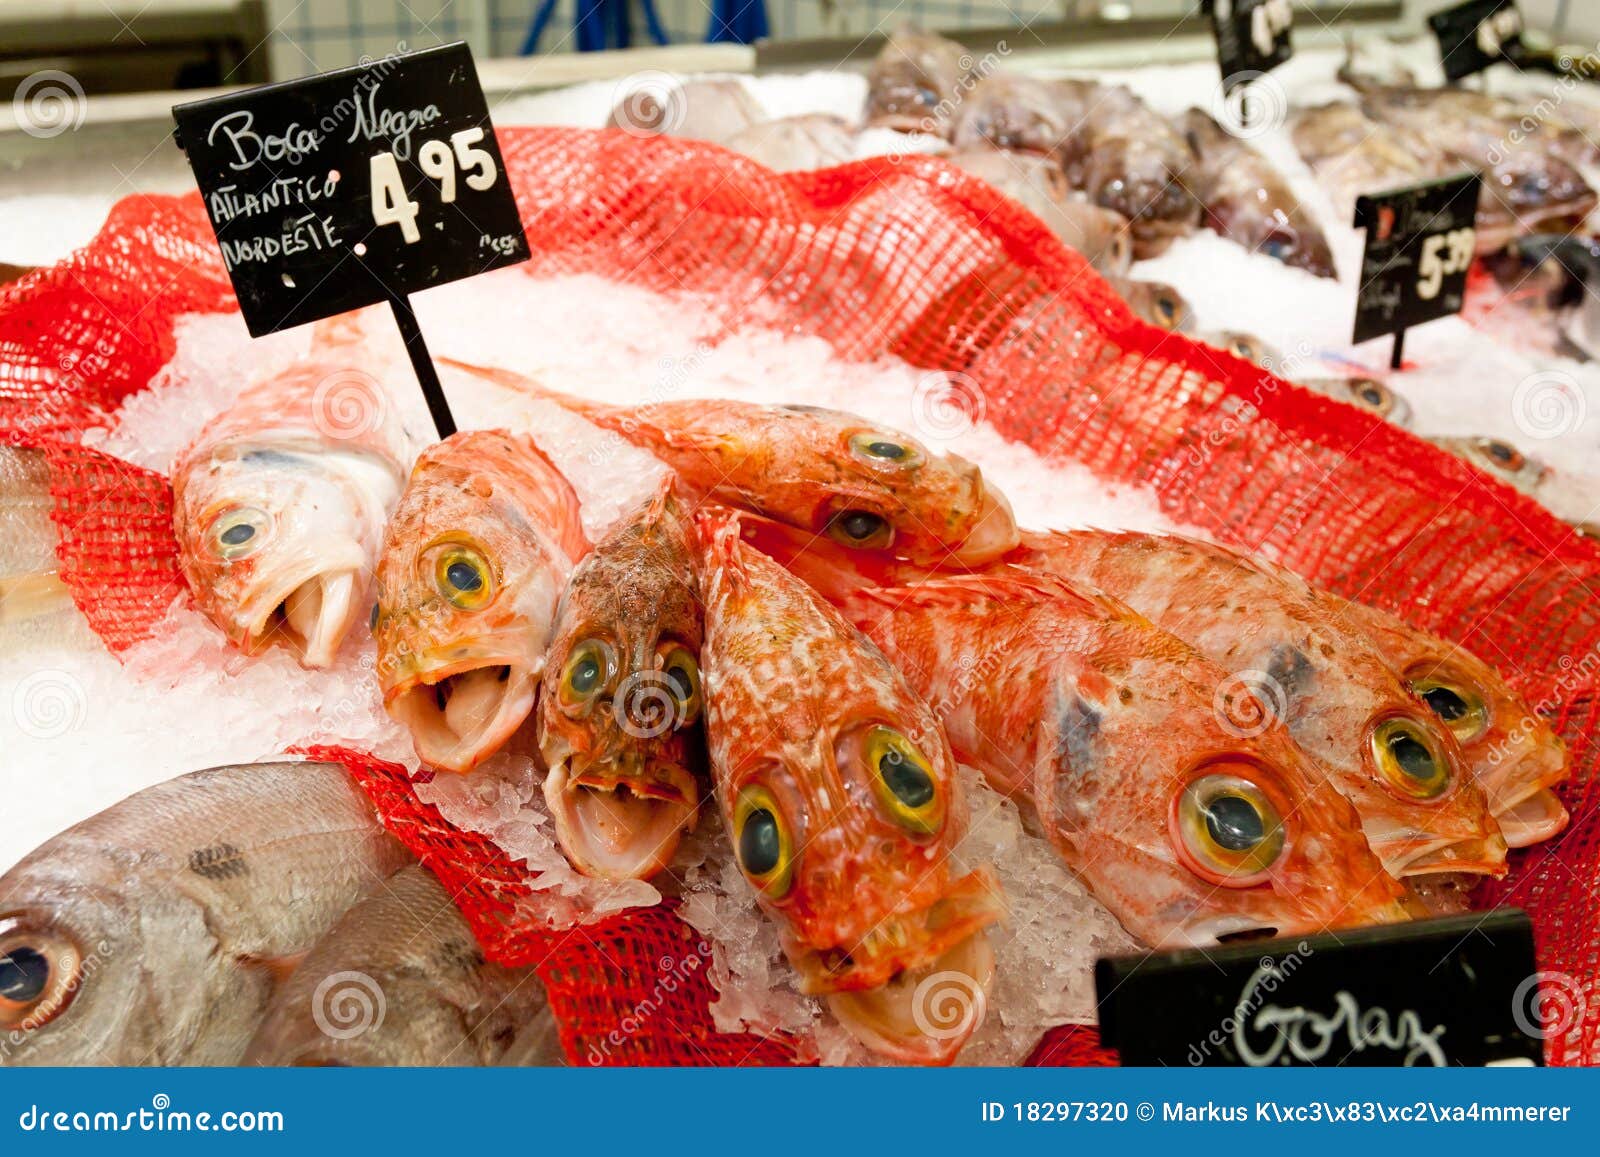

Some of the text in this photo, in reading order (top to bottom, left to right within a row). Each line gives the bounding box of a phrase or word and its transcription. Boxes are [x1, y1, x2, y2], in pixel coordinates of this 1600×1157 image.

[348, 83, 441, 161] Negra
[220, 213, 342, 272] NORDESTE
[1233, 966, 1446, 1066] Goraz
